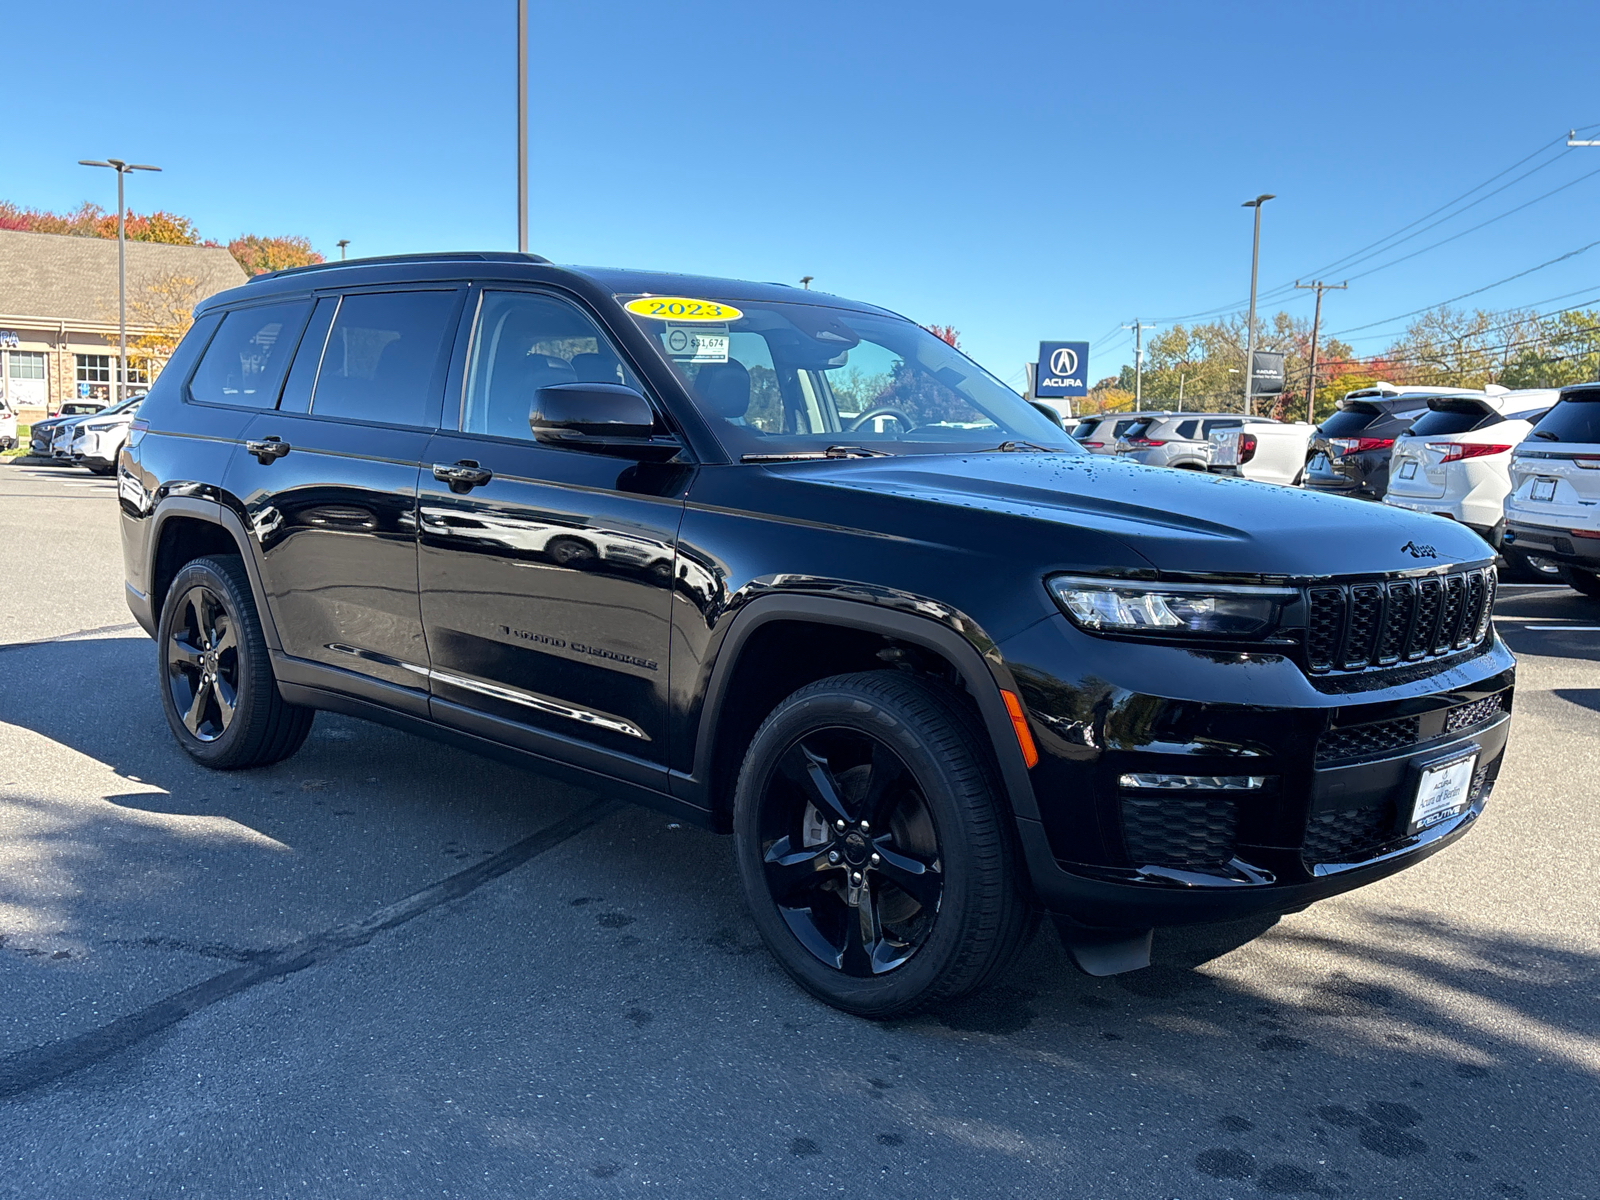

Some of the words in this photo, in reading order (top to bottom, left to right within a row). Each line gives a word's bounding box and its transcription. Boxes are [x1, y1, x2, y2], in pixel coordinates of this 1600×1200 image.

[649, 302, 721, 316] 2023
[690, 338, 724, 349] $31,674
[1042, 378, 1083, 387] ACURA
[1400, 540, 1437, 559] Jeep
[513, 629, 566, 648] GRAND
[570, 642, 658, 671] CHEROKEE
[1433, 779, 1451, 790] ACURA
[1418, 797, 1435, 810] Acura
[1436, 793, 1443, 803] of
[1443, 786, 1461, 800] Berlin
[1417, 805, 1460, 828] EXECUTIVE
